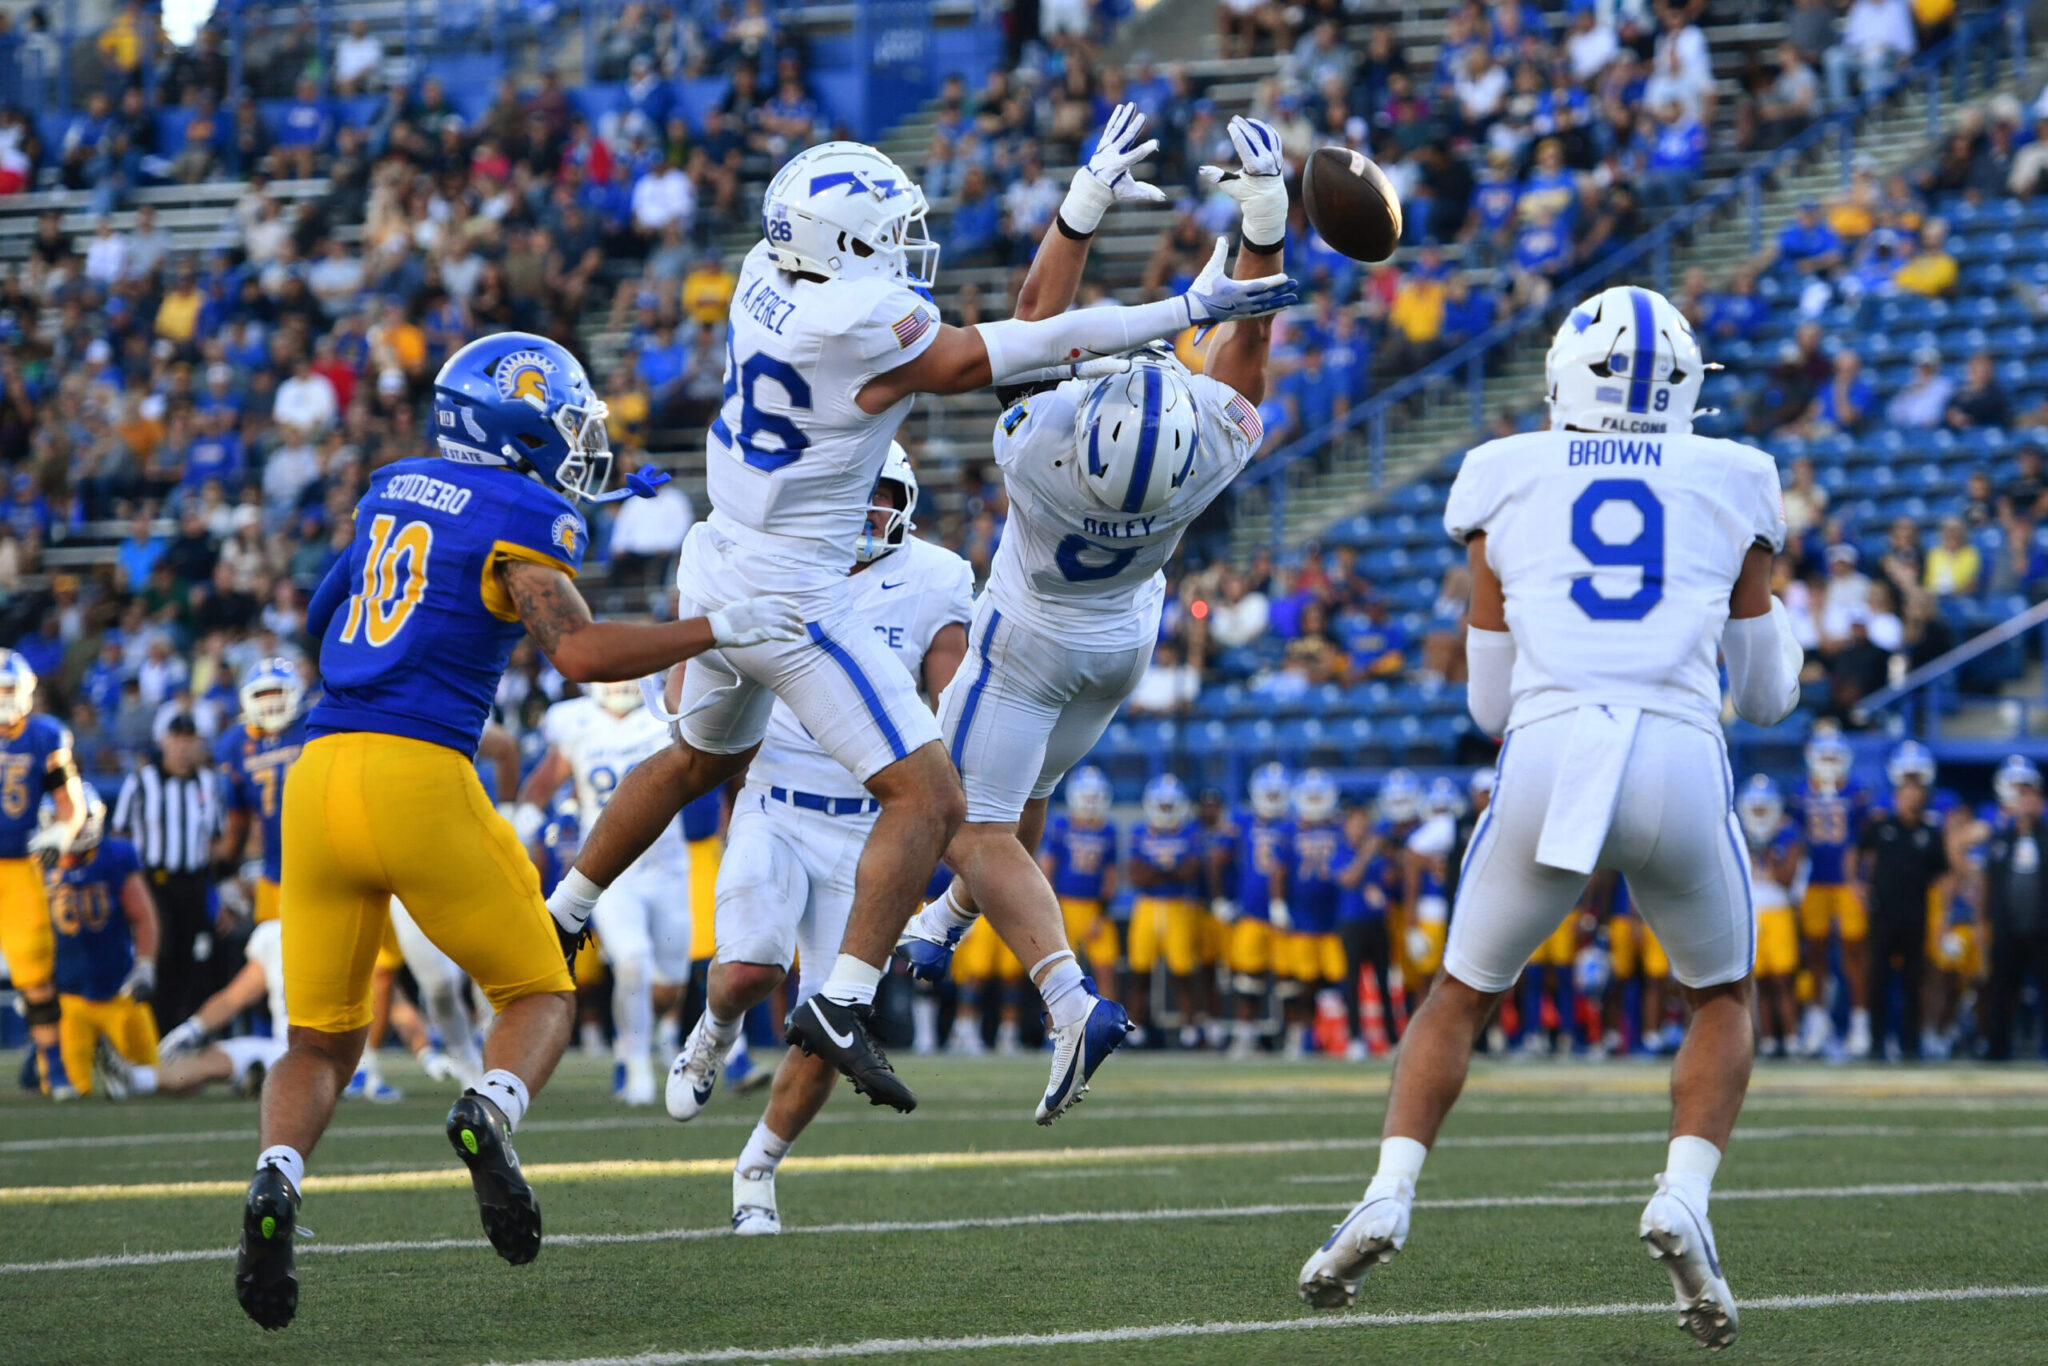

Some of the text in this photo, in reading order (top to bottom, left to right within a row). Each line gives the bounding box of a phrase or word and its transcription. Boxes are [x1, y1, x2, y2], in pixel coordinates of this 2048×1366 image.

[770, 219, 792, 241] 26
[1654, 388, 1669, 411] 9
[442, 412, 451, 424] 10
[1601, 417, 1667, 433] FALCONS
[449, 449, 482, 462] STATE
[1569, 439, 1662, 466] BROWN
[381, 474, 471, 515] SCUDERO
[1571, 480, 1664, 620] 9
[339, 514, 433, 648] 10
